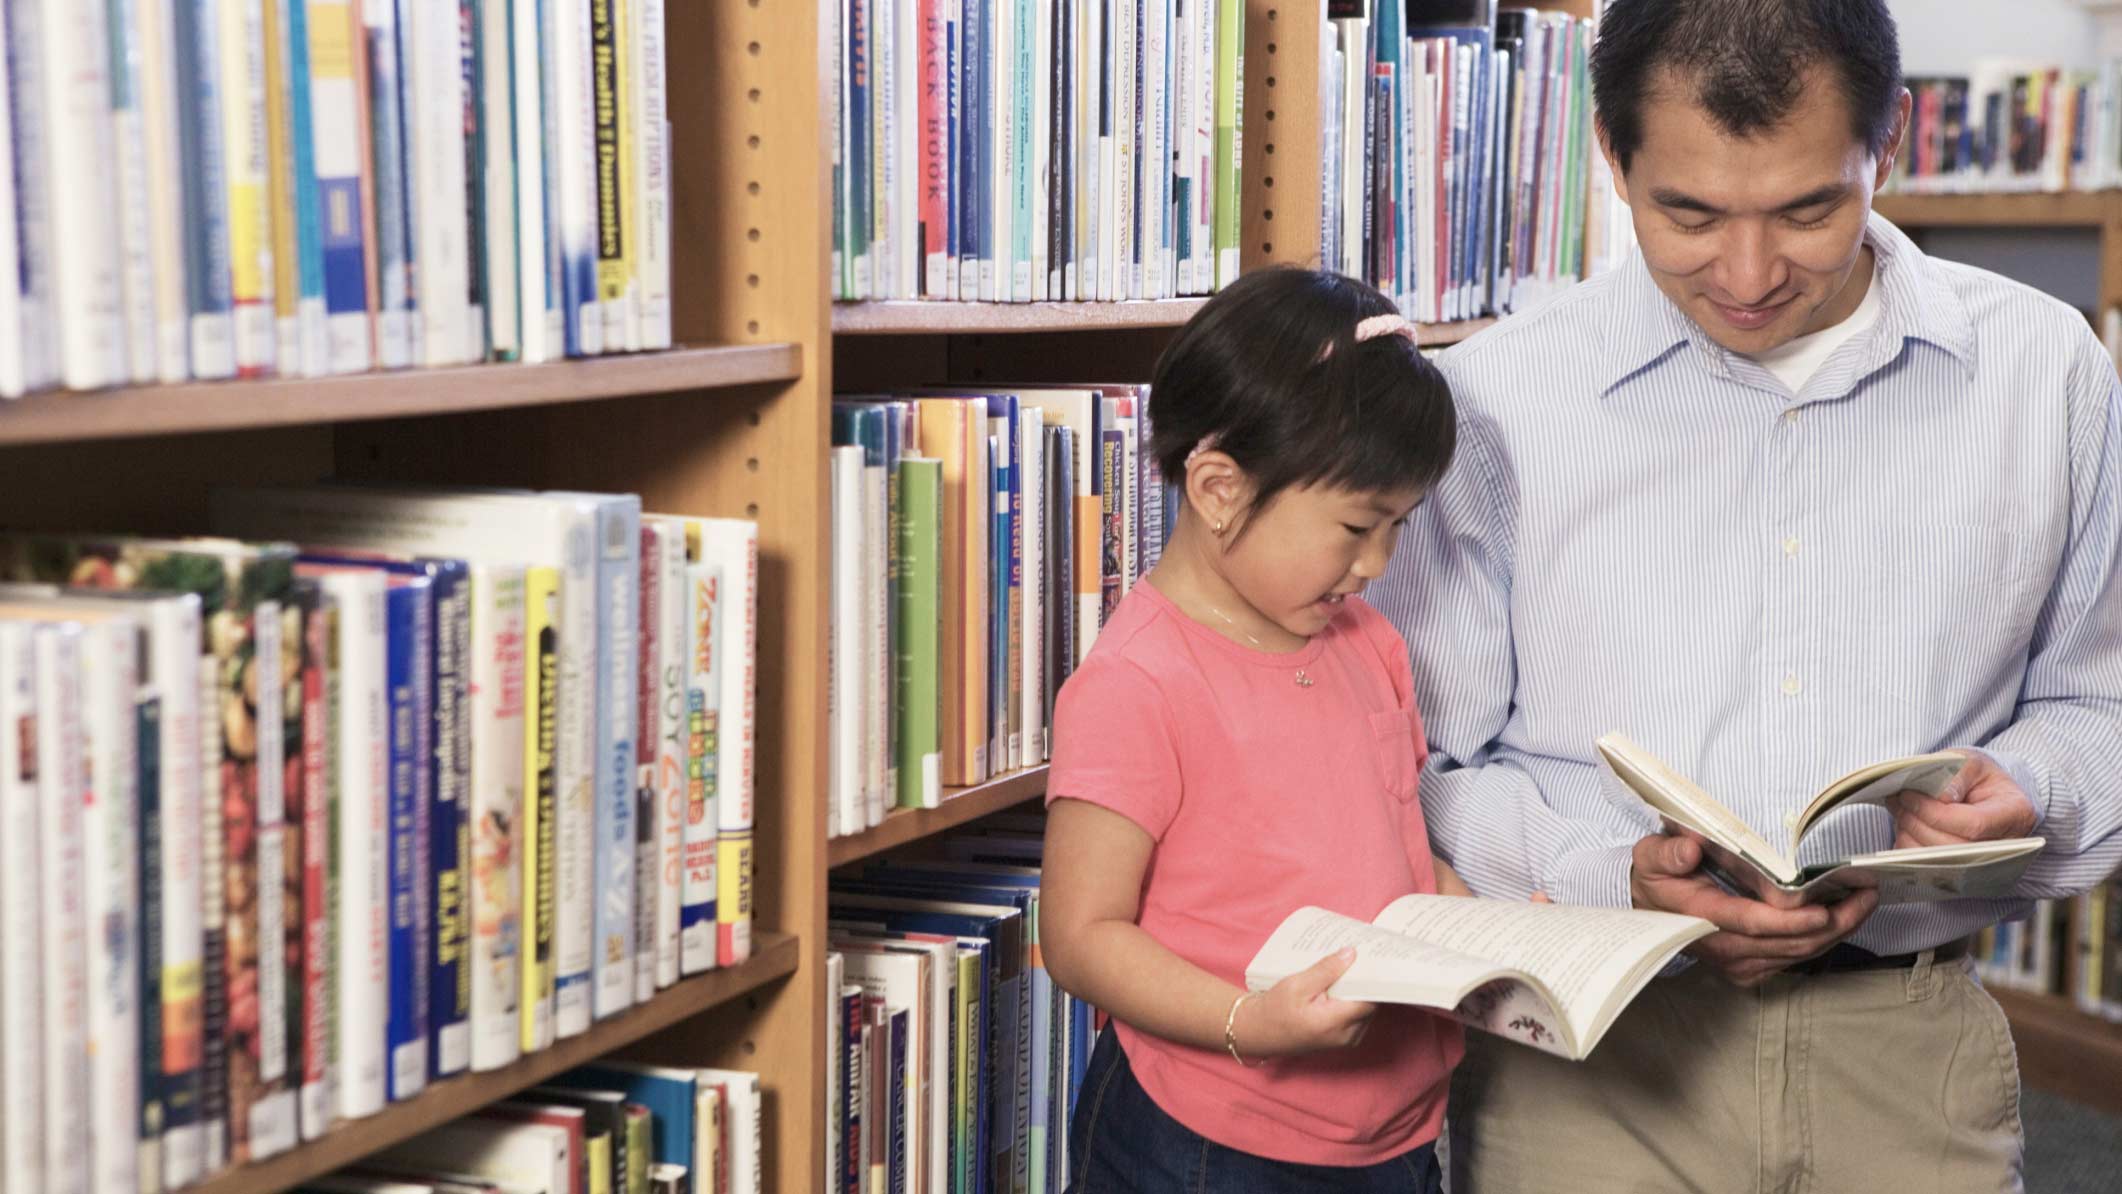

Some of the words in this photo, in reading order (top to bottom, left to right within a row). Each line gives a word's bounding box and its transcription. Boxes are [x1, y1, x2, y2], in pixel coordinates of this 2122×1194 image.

[926, 16, 941, 98] BACK
[927, 118, 942, 202] BOOK
[1103, 440, 1115, 514] Recovering
[1113, 489, 1121, 518] Soup
[1105, 515, 1113, 543] Soul
[664, 661, 683, 749] SOY
[613, 740, 633, 843] foods
[739, 846, 751, 915] SEARS
